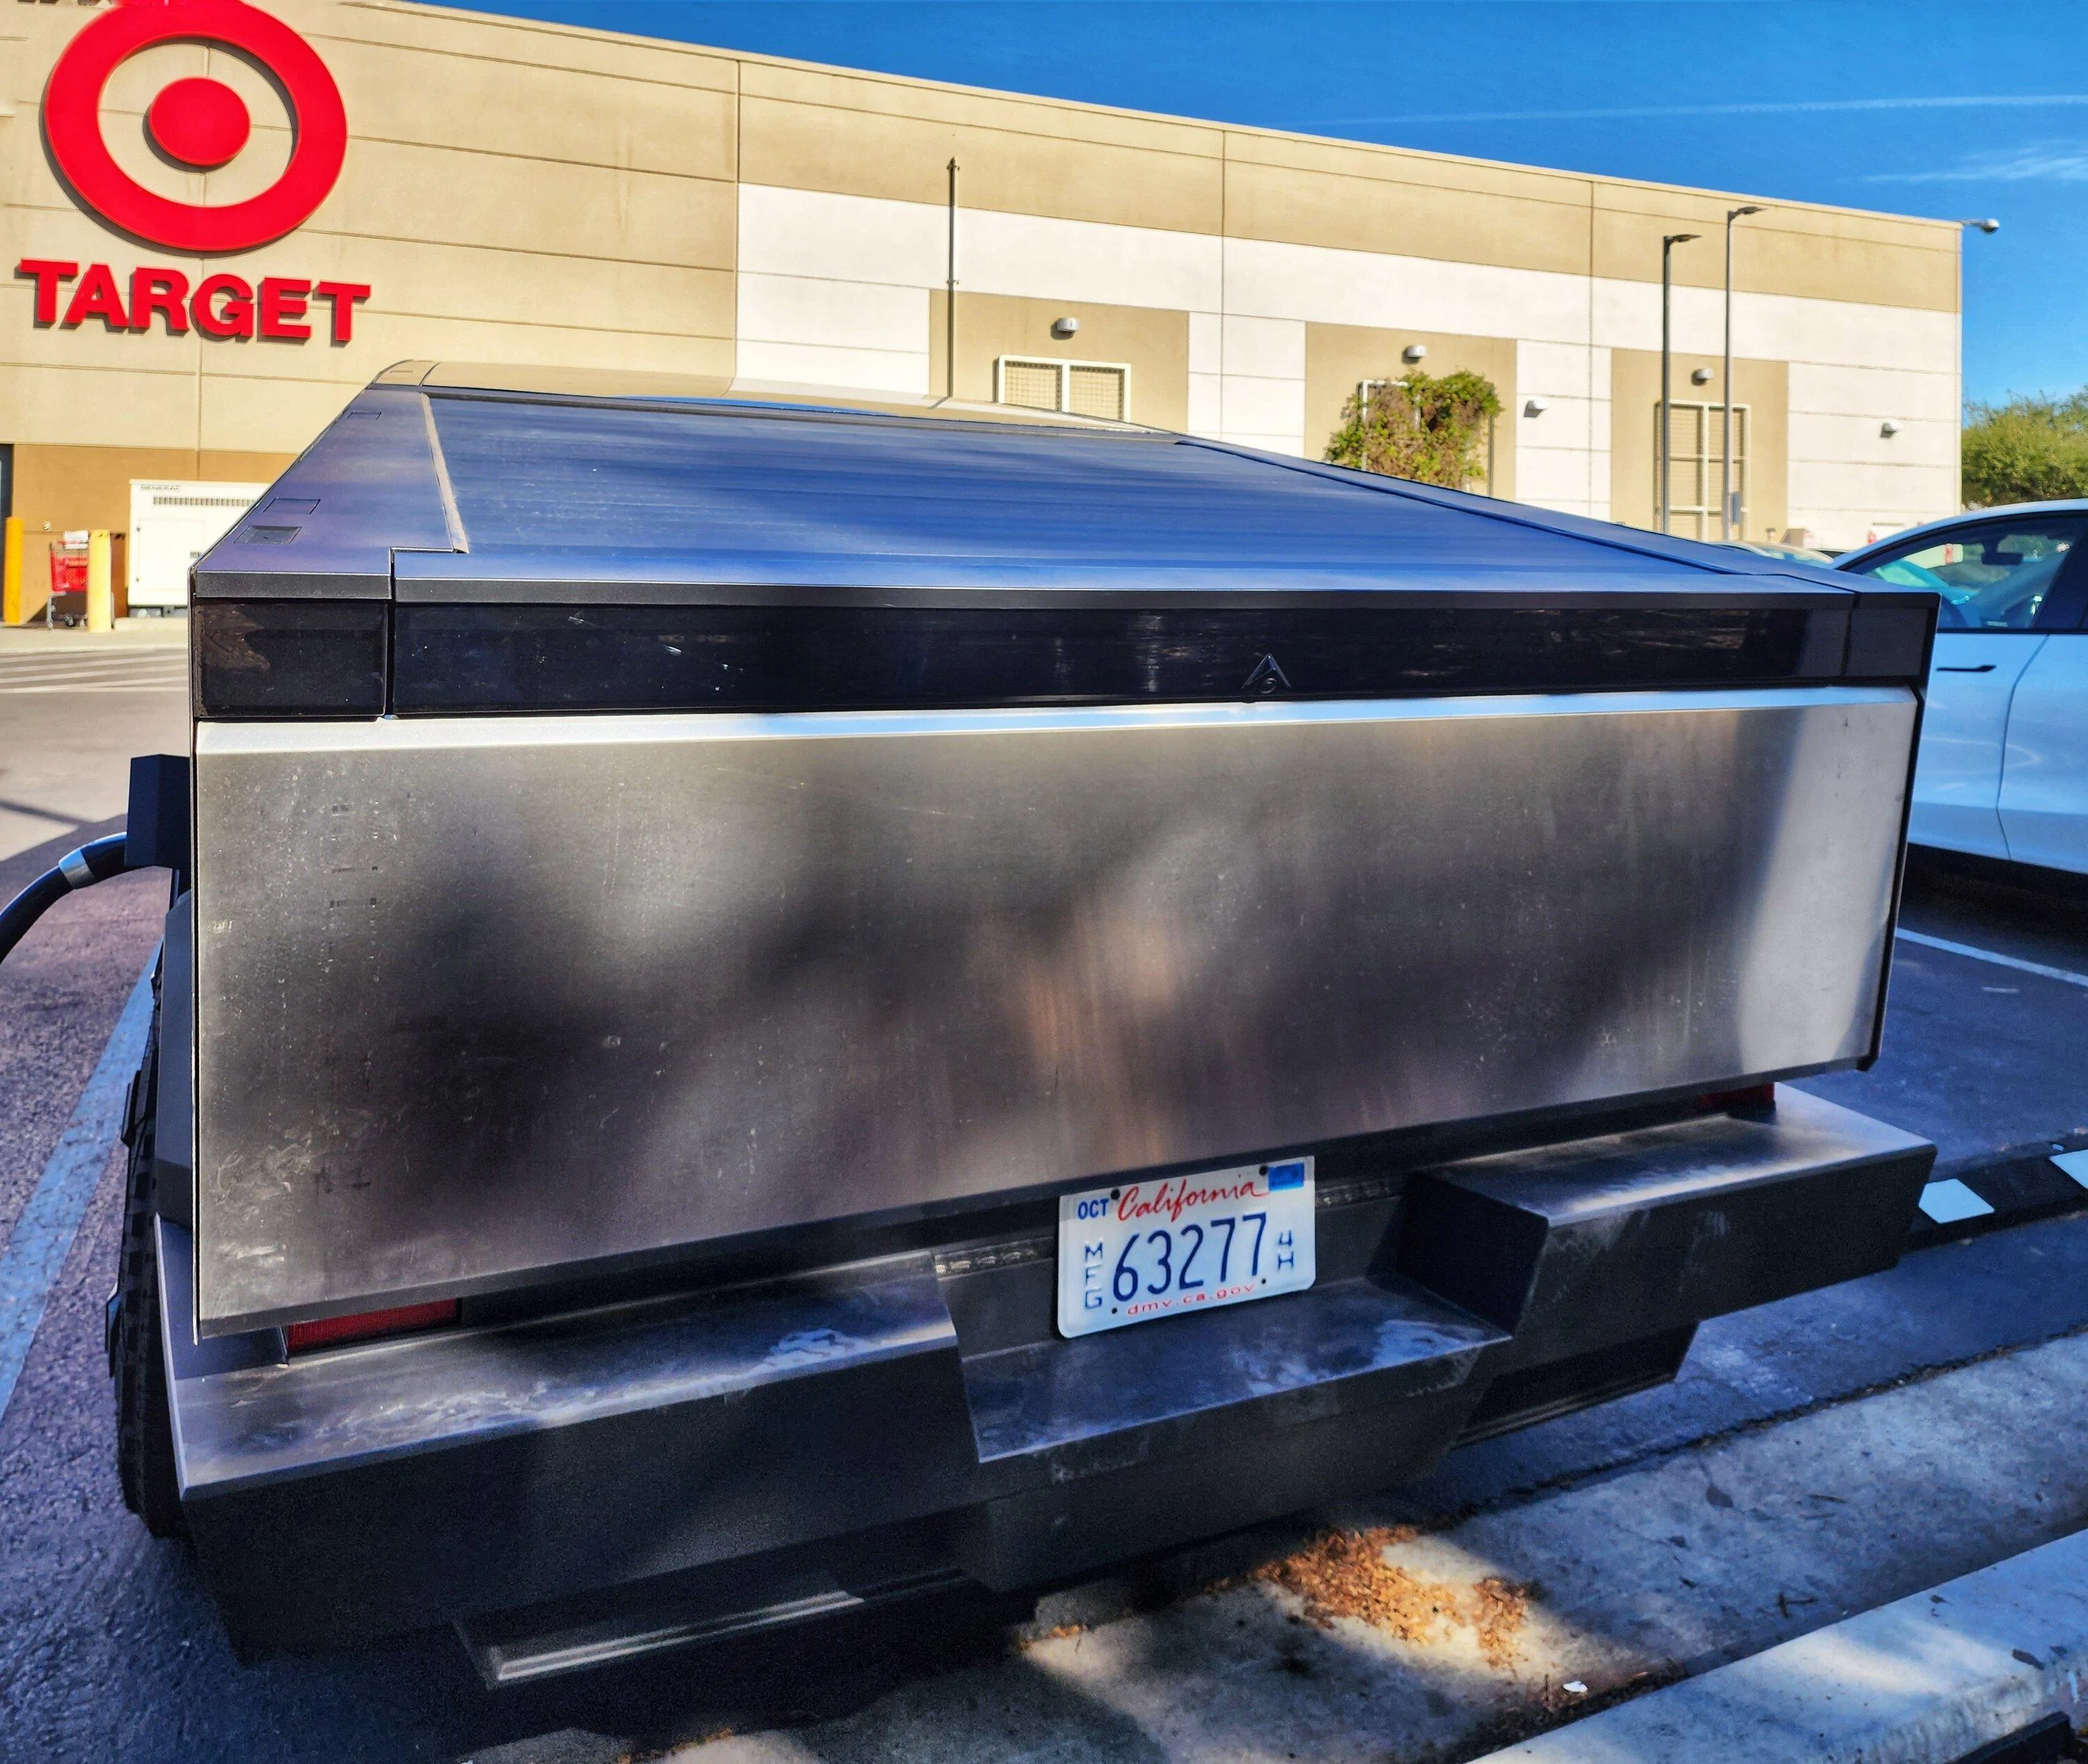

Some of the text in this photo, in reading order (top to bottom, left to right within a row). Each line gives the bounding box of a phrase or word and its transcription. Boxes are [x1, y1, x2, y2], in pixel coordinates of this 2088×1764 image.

[19, 258, 372, 342] TARGET
[1077, 1198, 1109, 1221] OCT
[1118, 1179, 1270, 1223] California
[1084, 1240, 1103, 1310] MFG
[1113, 1211, 1267, 1302] 63277
[1127, 1284, 1255, 1315] dmv.ca.gov
